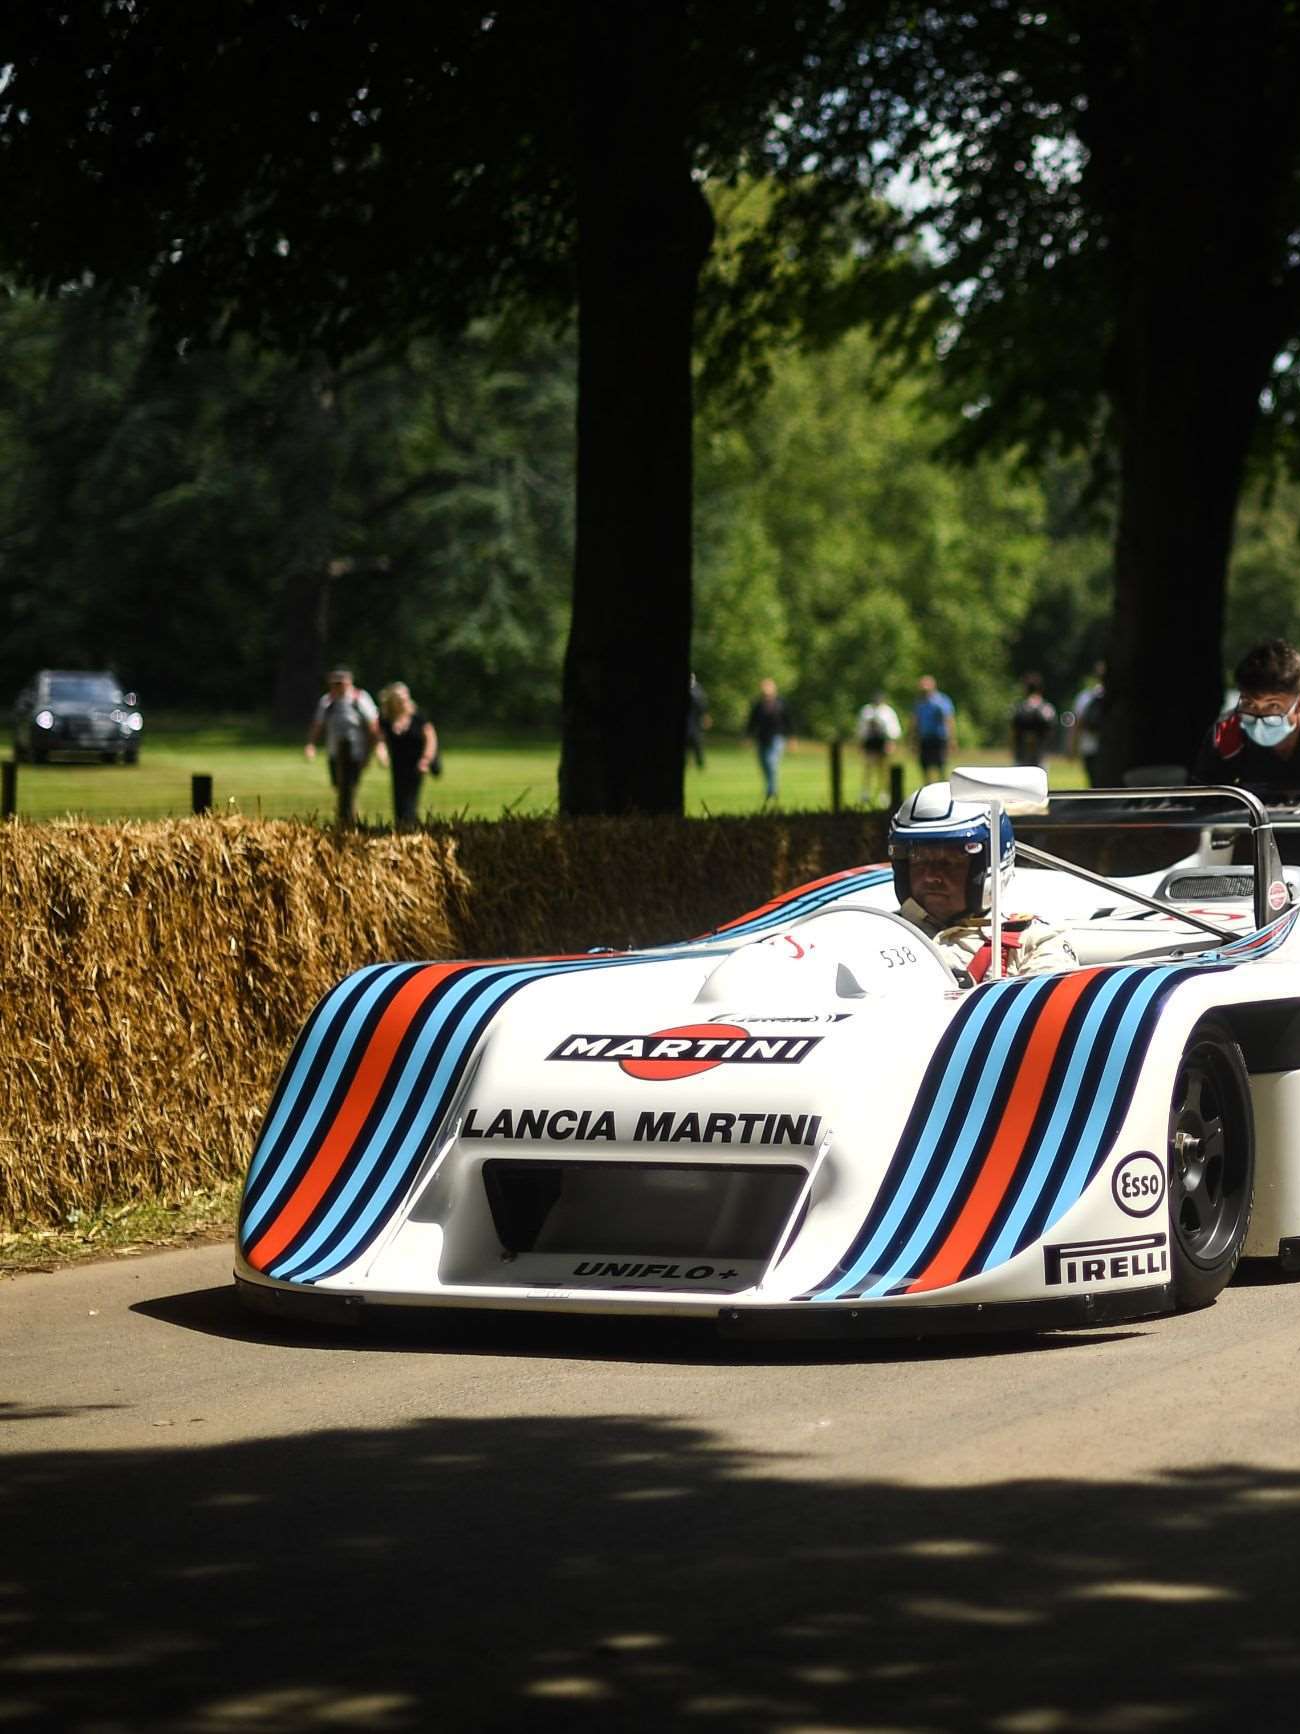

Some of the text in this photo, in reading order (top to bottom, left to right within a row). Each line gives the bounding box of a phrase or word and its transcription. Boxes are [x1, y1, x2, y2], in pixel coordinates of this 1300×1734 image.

[879, 946, 918, 969] 538
[560, 1036, 810, 1061] MARTINI
[460, 1108, 823, 1146] LANCIA MARTINI
[1043, 1231, 1167, 1286] PIRELLI
